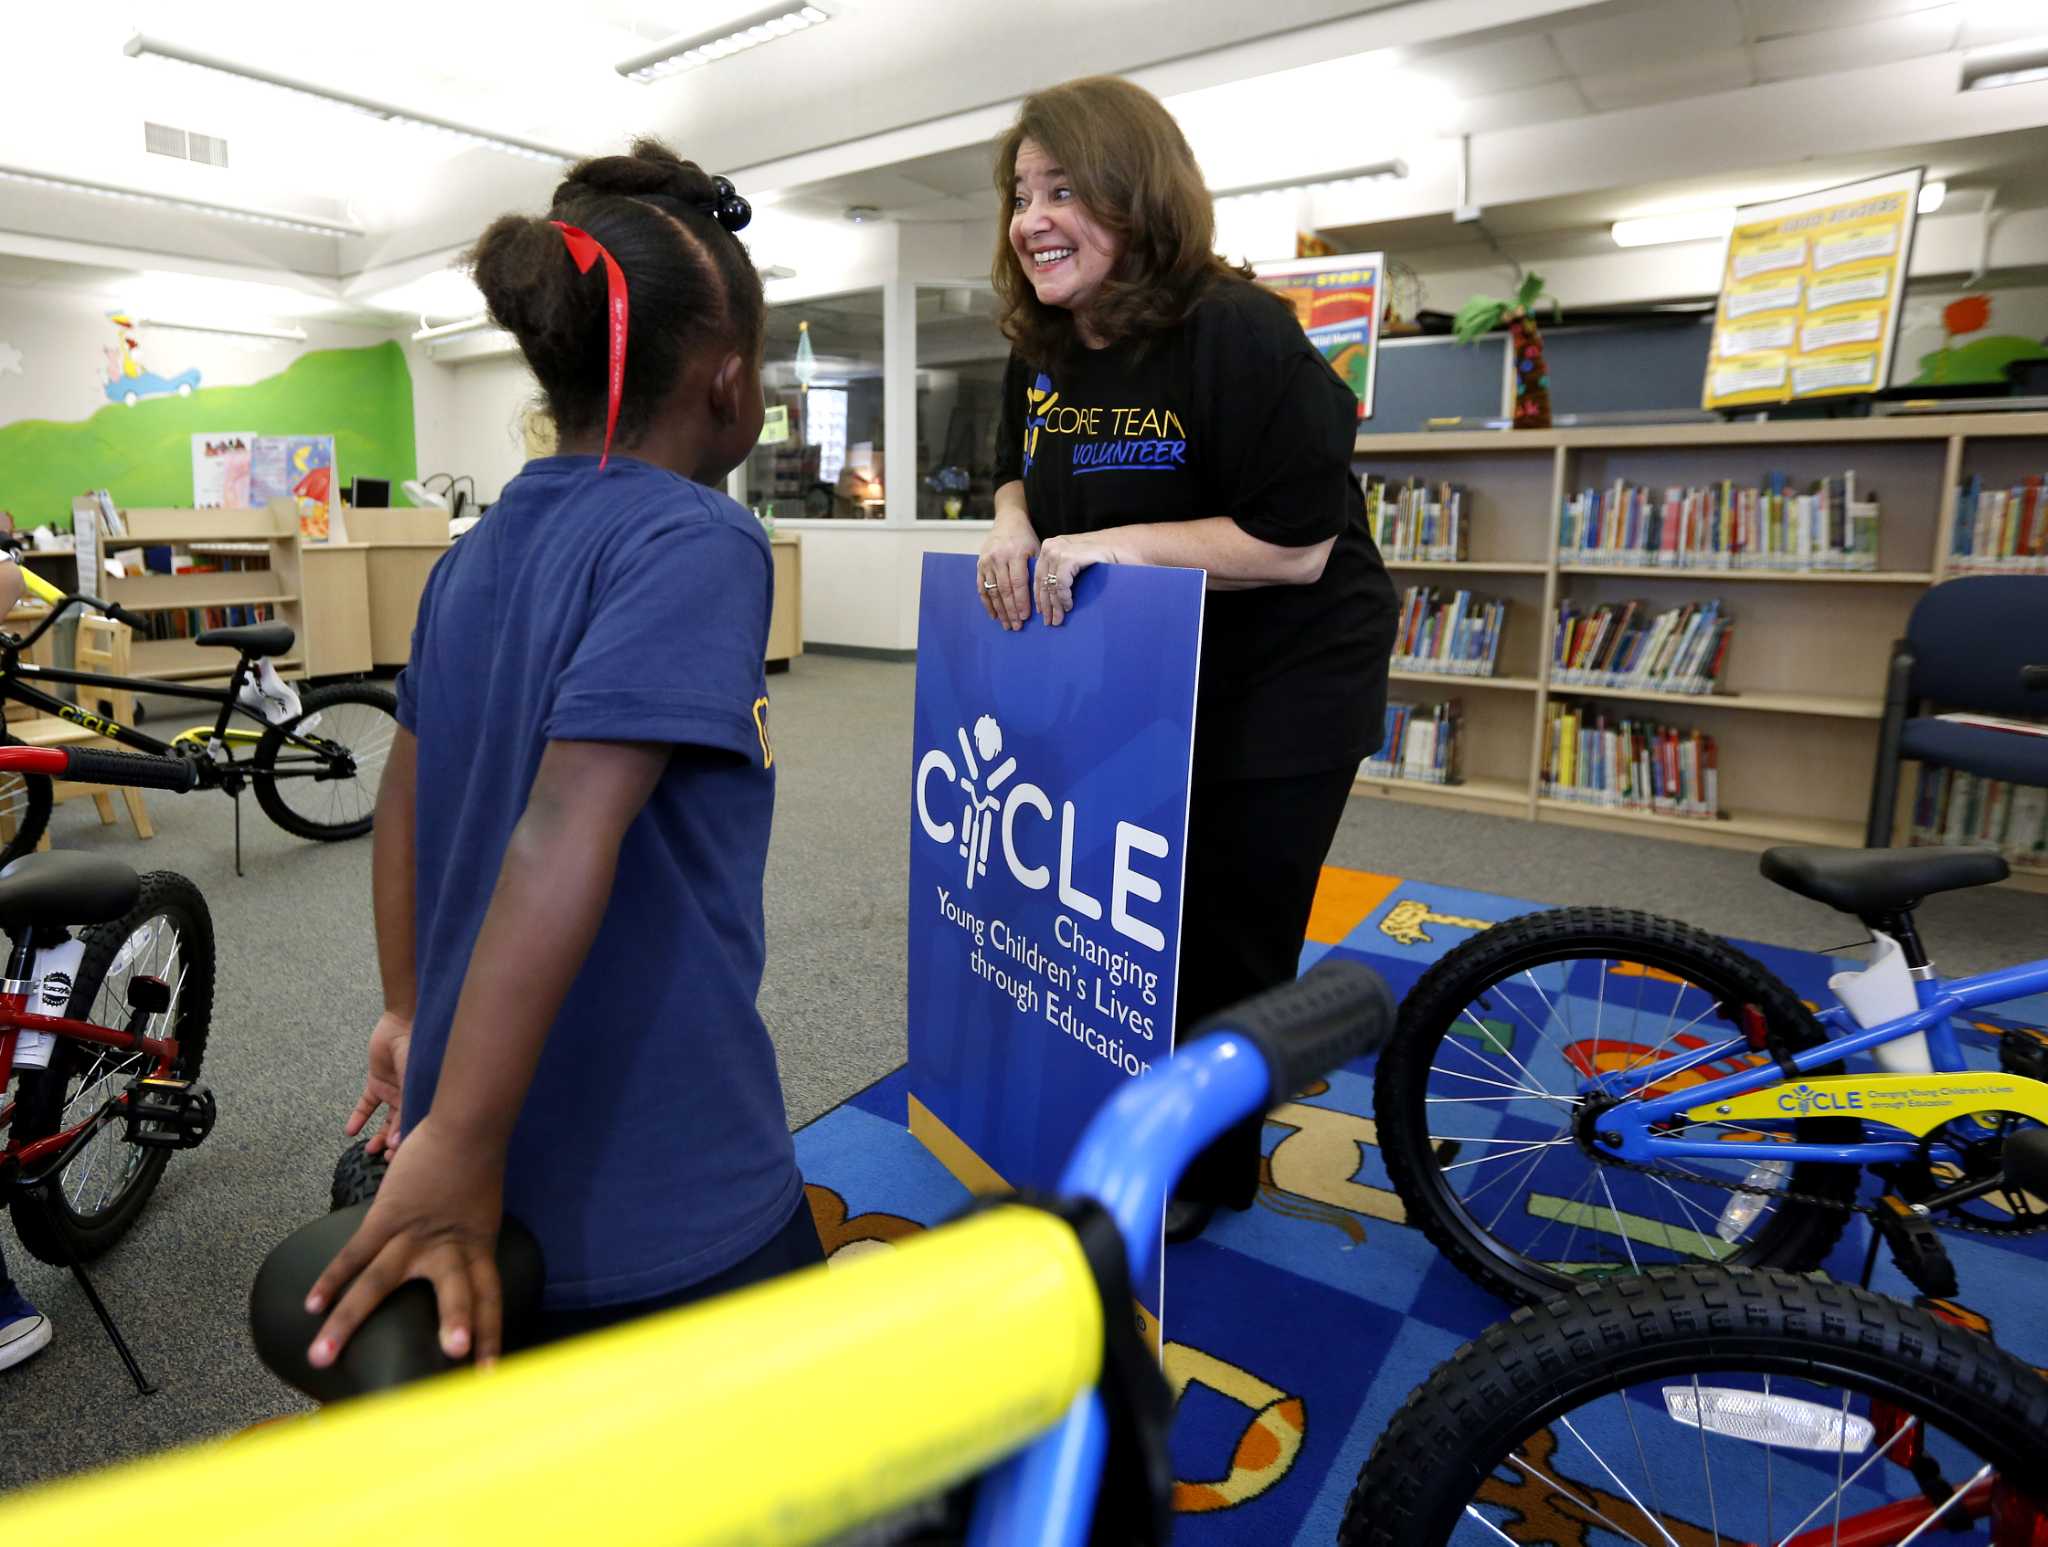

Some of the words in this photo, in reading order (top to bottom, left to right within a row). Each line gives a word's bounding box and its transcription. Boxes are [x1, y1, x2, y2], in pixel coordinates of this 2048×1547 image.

[1045, 407, 1103, 435] CORE
[1072, 440, 1186, 465] VOLUNTEER
[917, 714, 1170, 953] CYCLE
[937, 886, 985, 946] Young
[990, 919, 1087, 1000] Children's
[1095, 976, 1154, 1041] Lives
[970, 948, 1039, 1013] through
[1054, 914, 1158, 1006] Changing
[1778, 1086, 1863, 1115] CYCLE
